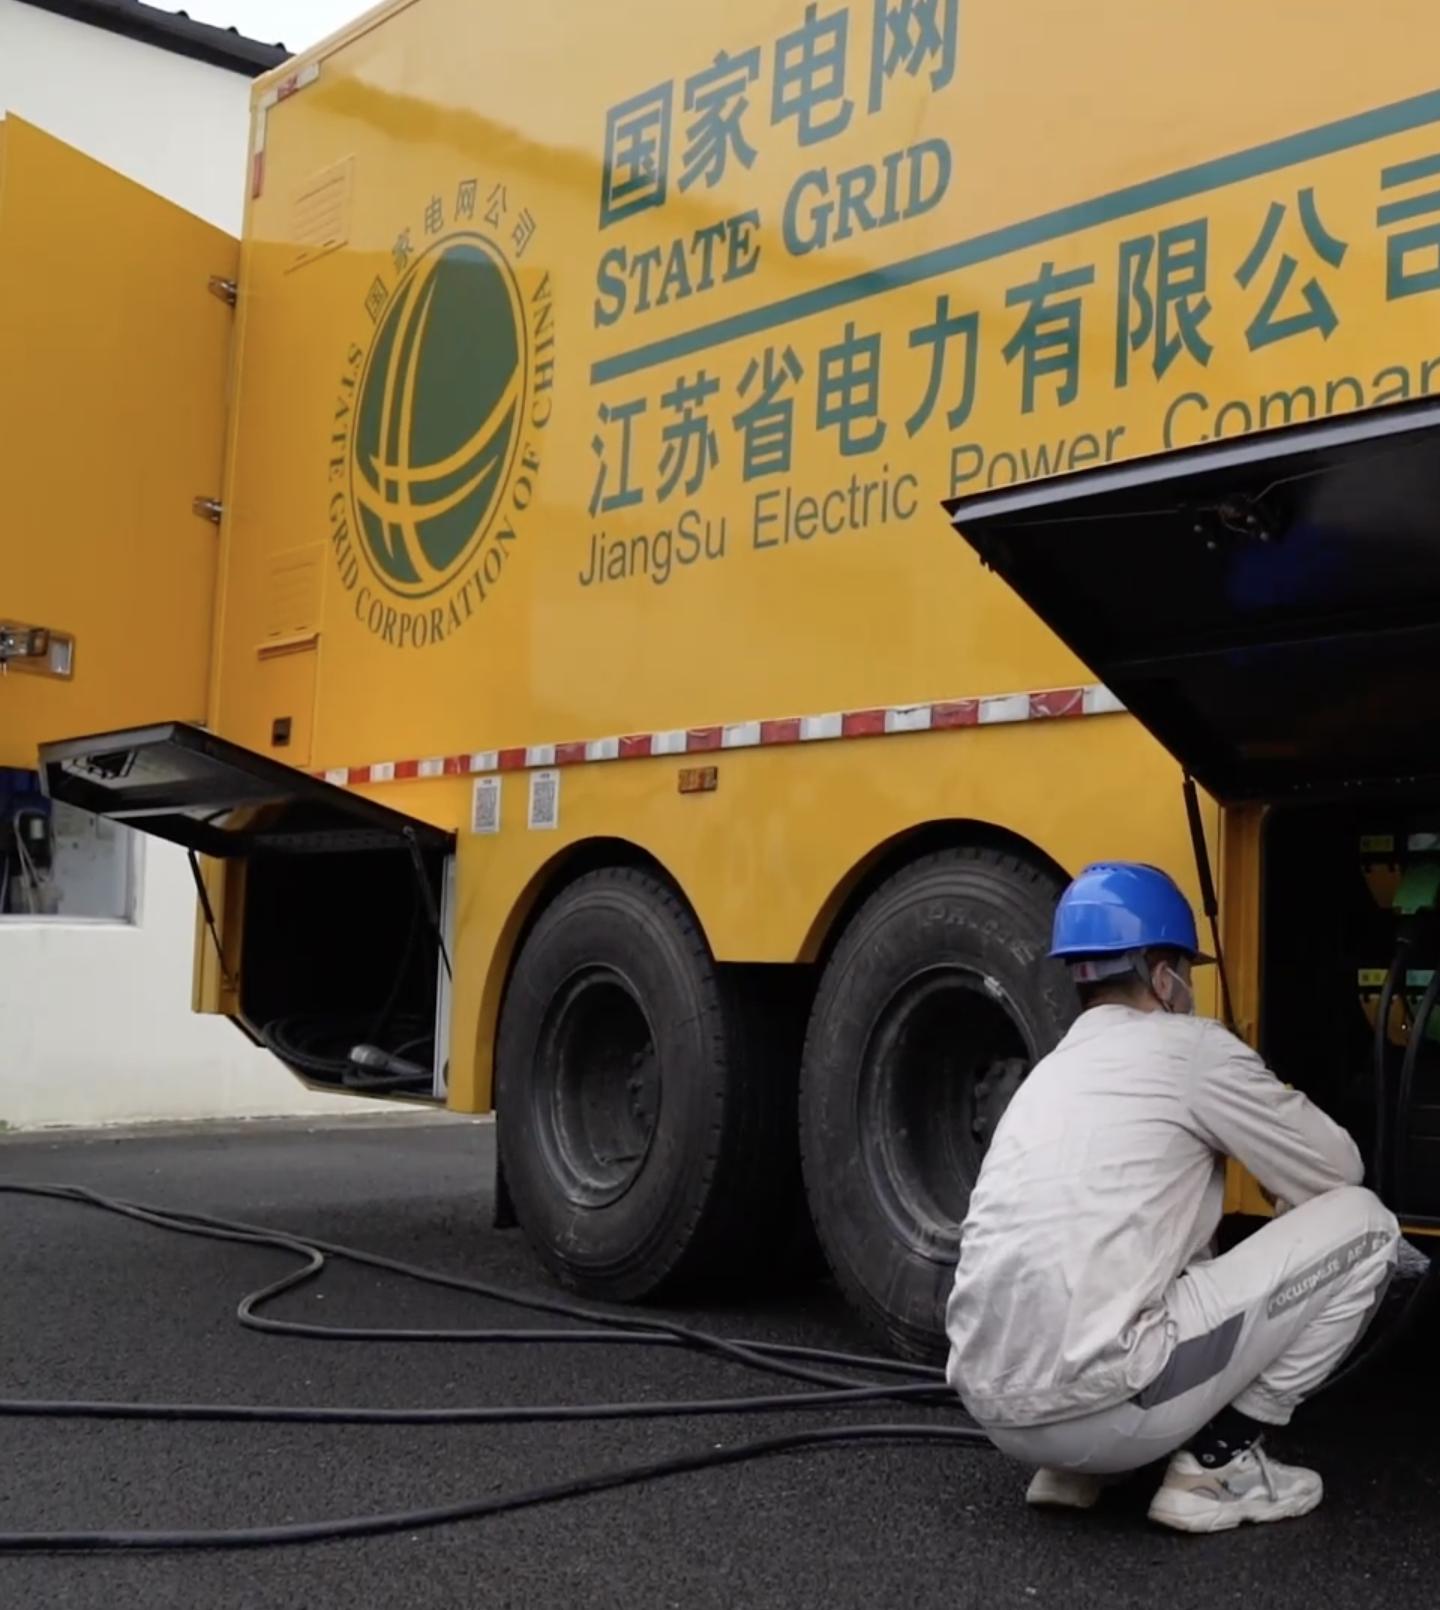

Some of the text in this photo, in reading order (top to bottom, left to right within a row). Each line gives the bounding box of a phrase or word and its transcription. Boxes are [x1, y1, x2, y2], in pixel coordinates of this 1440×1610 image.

[598, 0, 958, 231] 国家电网
[364, 178, 537, 326] 国家电网公司
[594, 137, 953, 329] STATE GRID
[329, 270, 555, 649] STATE GRID CORPORATION OF CHINA
[578, 508, 726, 586] JiangSu
[752, 463, 919, 549] Electric
[950, 425, 1126, 498] Power
